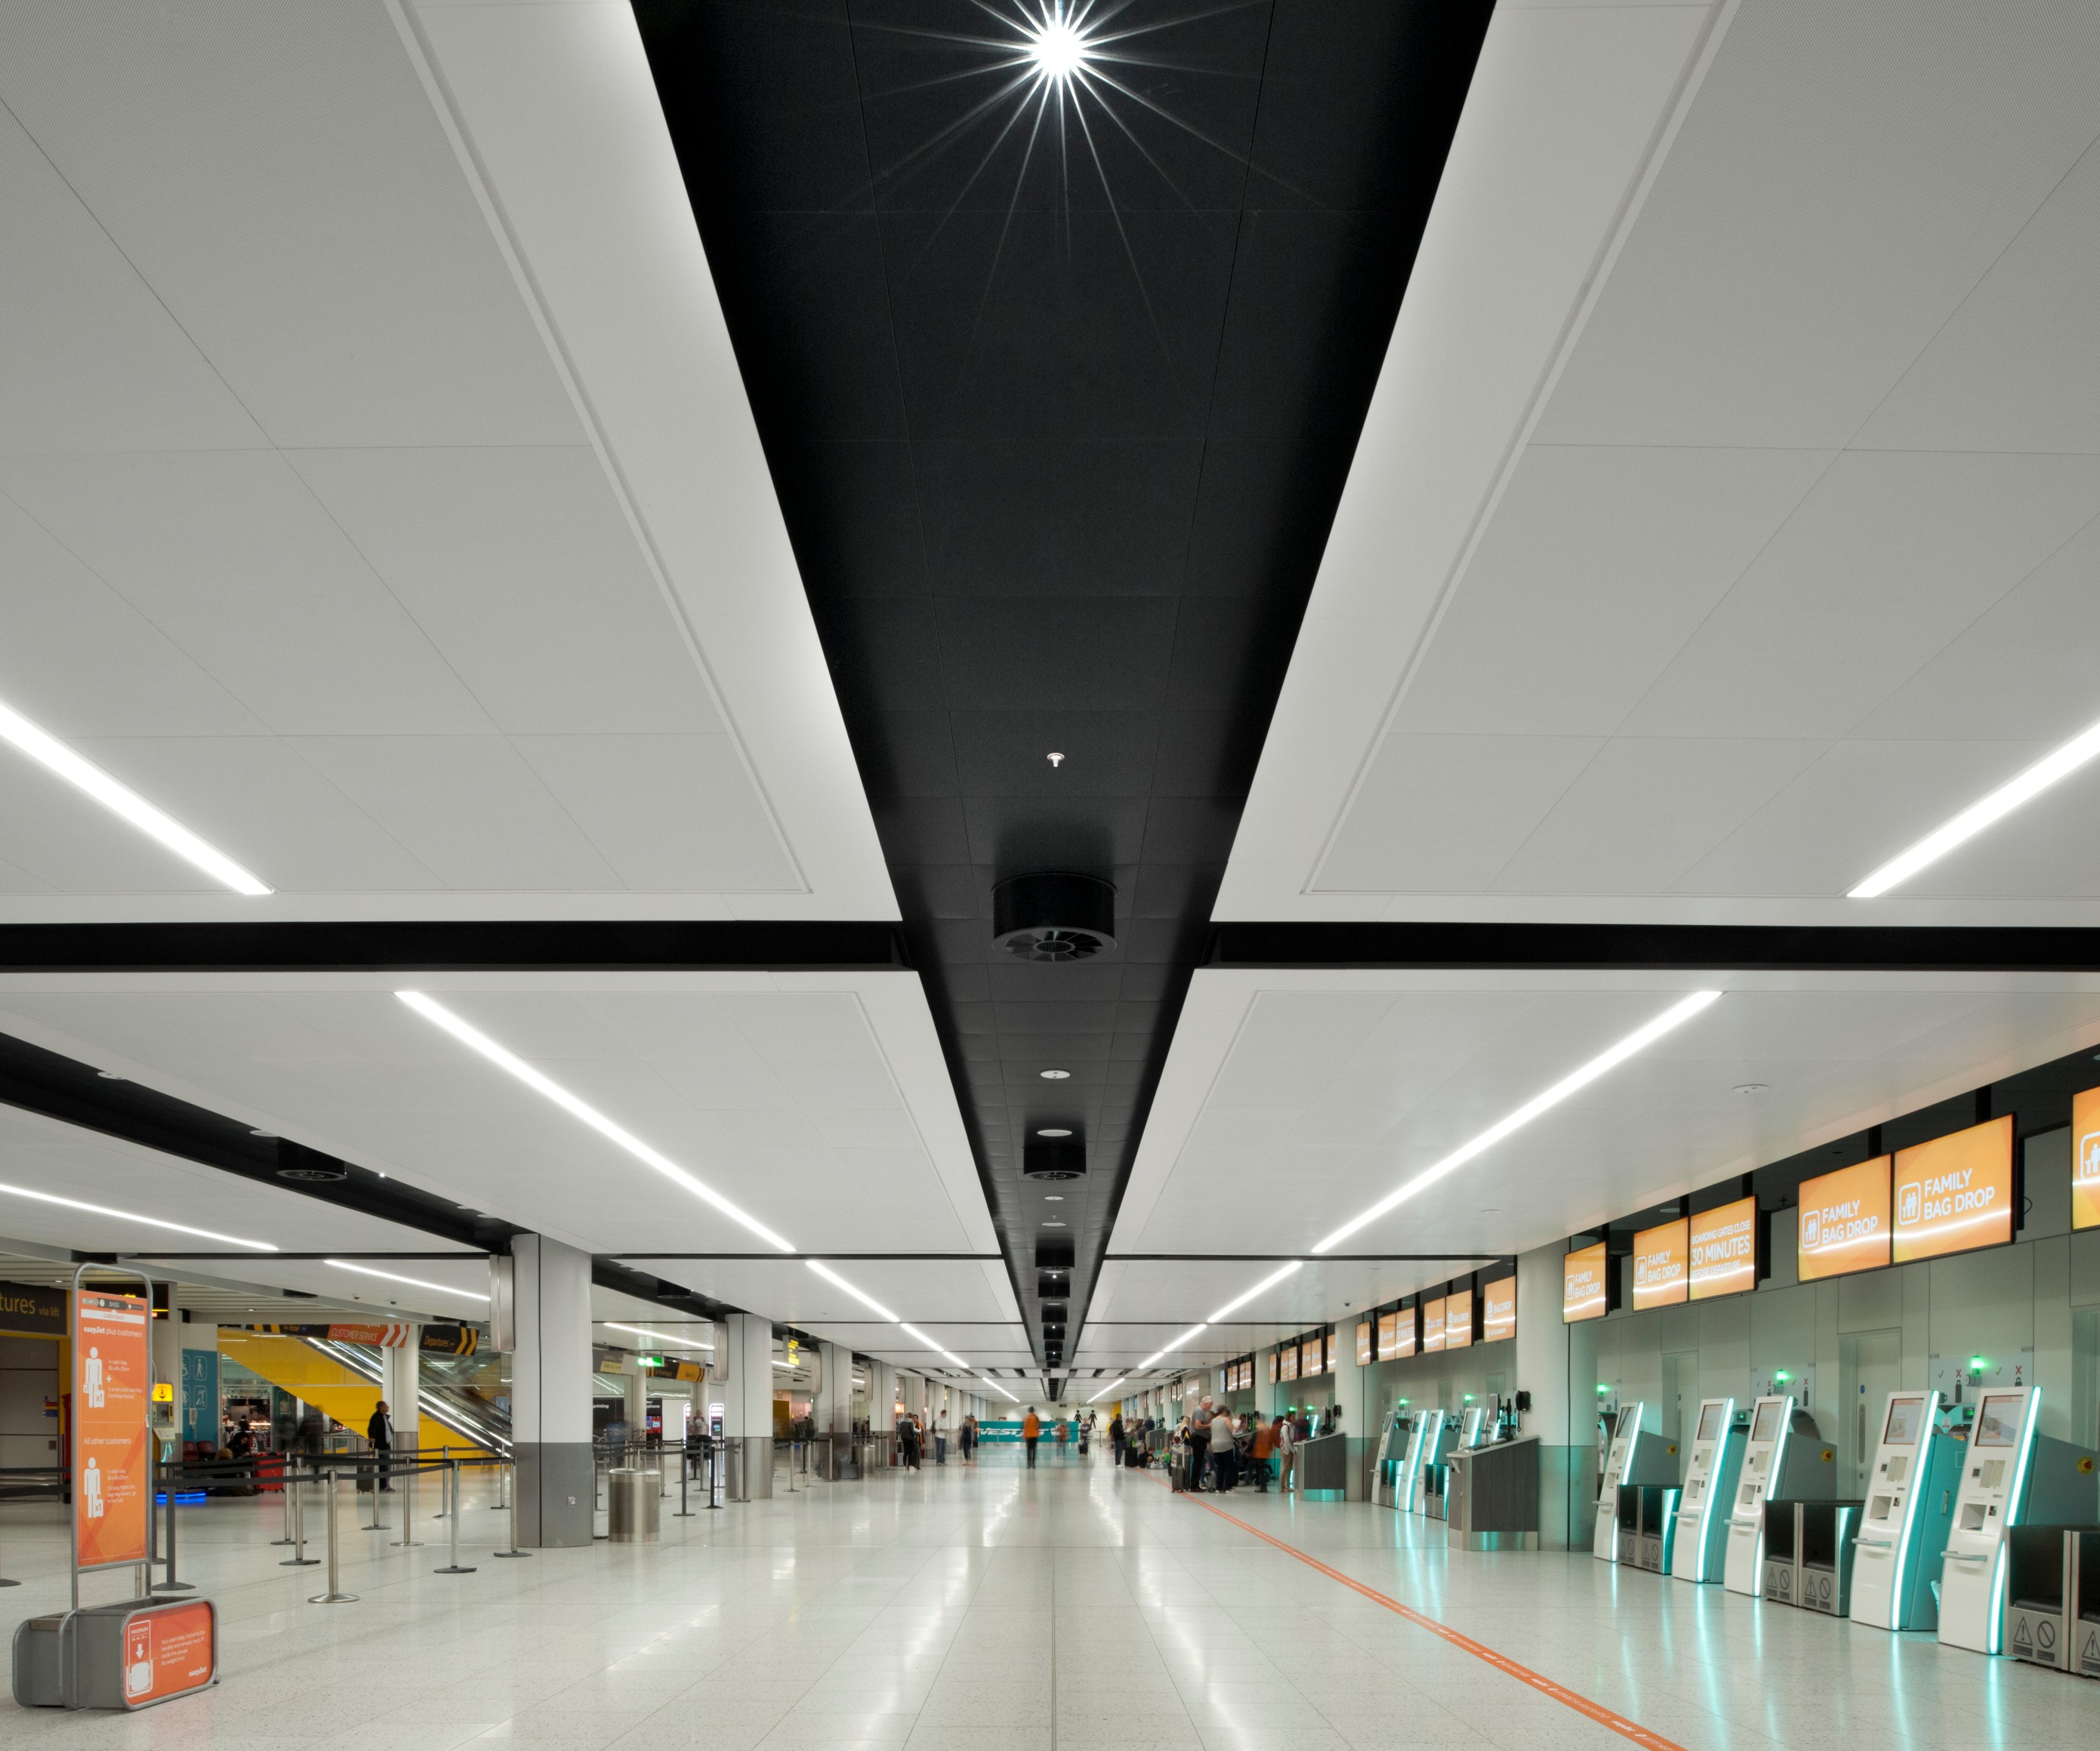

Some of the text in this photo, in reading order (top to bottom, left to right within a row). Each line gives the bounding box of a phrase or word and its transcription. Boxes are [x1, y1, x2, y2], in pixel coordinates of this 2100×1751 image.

[1924, 1167, 1972, 1198] FAMILY
[1924, 1185, 1995, 1221] BAG DROP
[1822, 1198, 1861, 1225] FAMILY
[1691, 1219, 1751, 1245] BOARDING GATES CLOSE
[1822, 1216, 1879, 1244] BAG DROP
[1647, 1250, 1671, 1266] FAMILY
[1691, 1234, 1750, 1266] 30 MINUTES
[1648, 1263, 1681, 1282] BAG DROP
[1710, 1259, 1741, 1276] DEPARTURE
[1574, 1270, 1593, 1286] FAMILY
[1574, 1281, 1601, 1298] BAG DROP
[39, 1306, 49, 1315] via
[50, 1306, 60, 1317] lift
[1493, 1300, 1513, 1314] BAG DROP
[84, 1327, 106, 1335] easyJet
[117, 1329, 143, 1338] customers
[331, 1327, 378, 1342] CUSTOMER SERVICE
[424, 1335, 449, 1348] Departures
[96, 1394, 103, 1402] x1
[978, 1427, 1049, 1438] WESTJT
[95, 1503, 102, 1512] x1
[131, 1626, 149, 1635] MAXIMUM
[189, 1666, 207, 1677] easyJet
